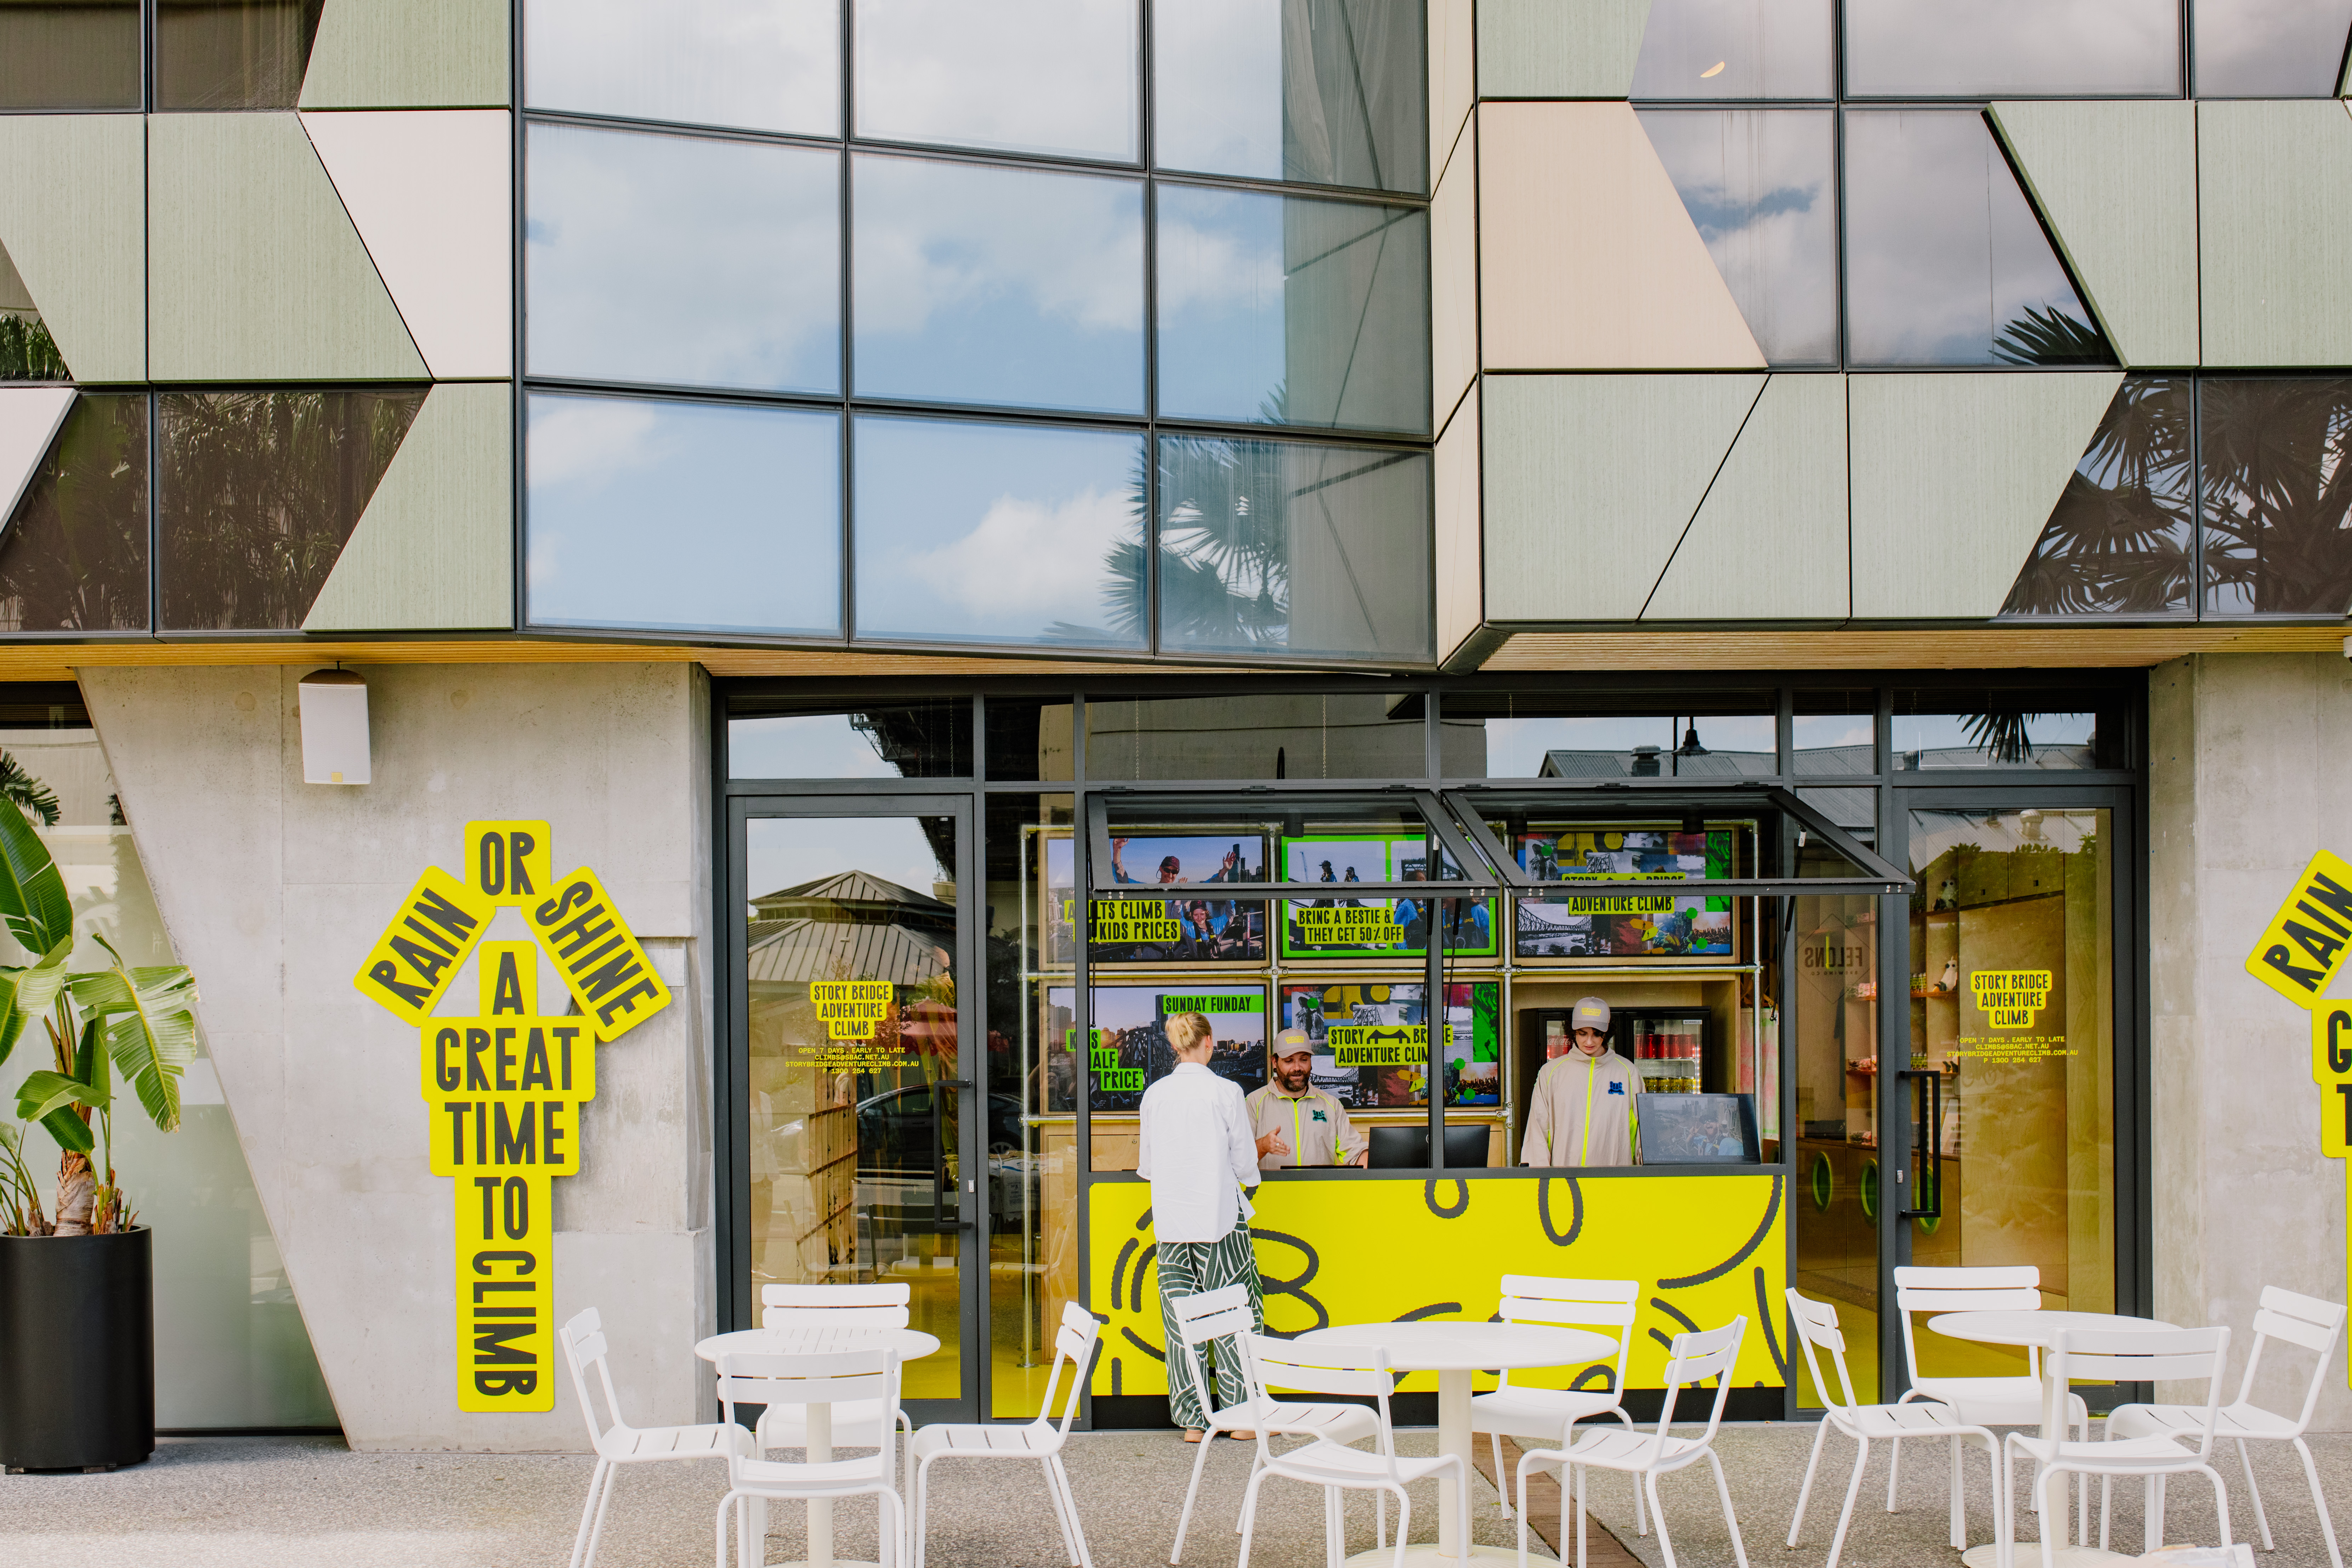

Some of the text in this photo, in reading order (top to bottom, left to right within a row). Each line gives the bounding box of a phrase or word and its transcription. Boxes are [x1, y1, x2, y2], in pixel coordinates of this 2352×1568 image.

[1121, 901, 1162, 919] CLIMB
[1571, 897, 1672, 911] ADVENTURE CLIMB
[1299, 910, 1391, 924] BRING A BESTIE &
[368, 832, 659, 1027] RAIN OR SHINE
[1100, 922, 1128, 940] KIDS
[1134, 921, 1177, 939] PRICES
[1307, 927, 1401, 941] THEY GET 50% OFF
[2262, 871, 2352, 993] RAIN
[493, 952, 525, 1014] A
[1975, 974, 2048, 990] STORY BRIDGE
[814, 985, 889, 1000] STORY BRIDGE
[1981, 992, 2041, 1007] ADVENTURE
[821, 1003, 882, 1018] ADVENTURE
[1166, 996, 1251, 1012] SUNDAY FUNDAY
[1995, 1010, 2028, 1025] CLIMB
[835, 1021, 869, 1036] CLIMB
[1331, 1028, 1450, 1045] STORY BRE
[1070, 1032, 1098, 1049] KS
[436, 1028, 579, 1091] GREAT
[1090, 1051, 1115, 1069] ALF
[1338, 1047, 1428, 1063] ADVENTURE CLIM
[1610, 1081, 1622, 1089] SBAC
[445, 1102, 564, 1165] TIME
[475, 1176, 528, 1240] TO
[473, 1251, 537, 1396] CLIMB
